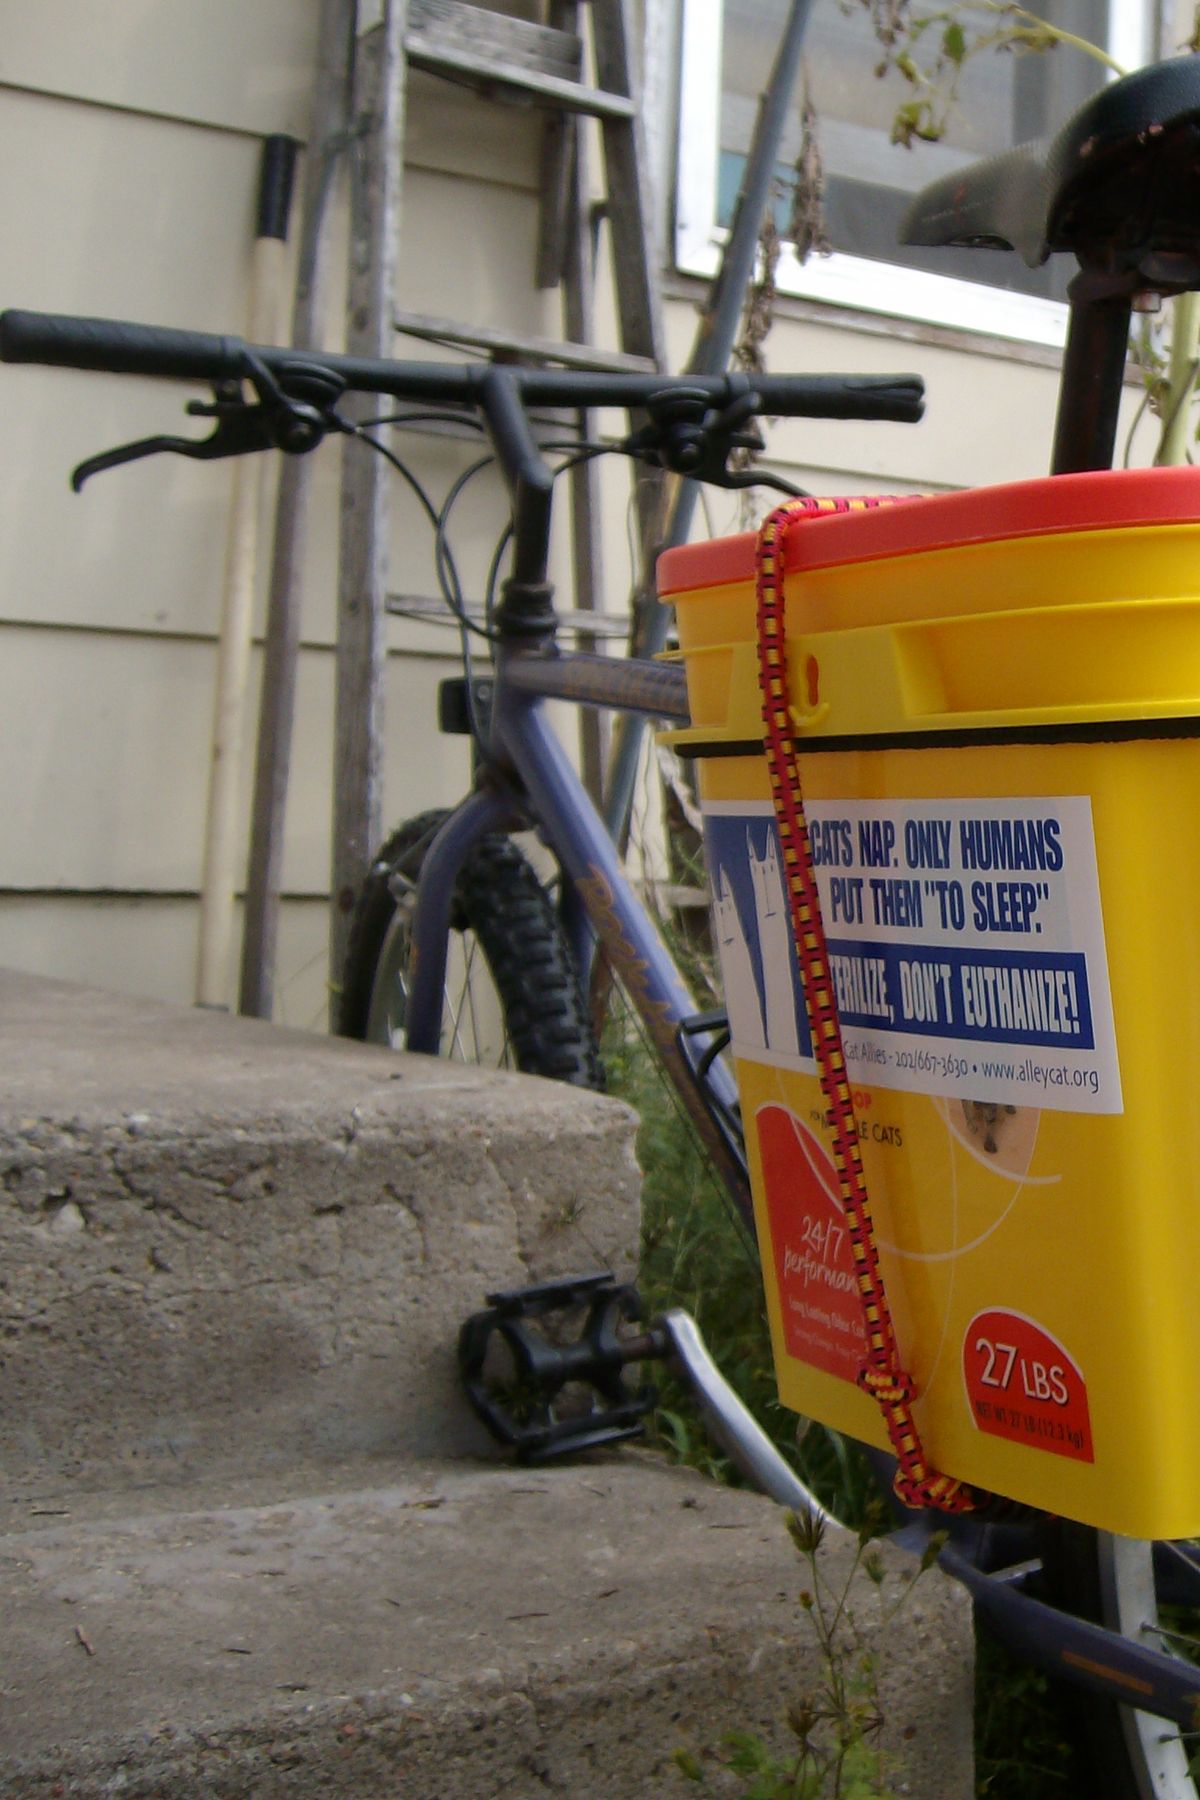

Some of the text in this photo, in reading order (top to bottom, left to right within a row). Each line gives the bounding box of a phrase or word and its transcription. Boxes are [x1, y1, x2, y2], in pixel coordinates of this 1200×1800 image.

[808, 818, 1064, 872] CATS NAP. ONLY HUMANS
[829, 876, 864, 924] PUT
[869, 877, 924, 929] THEM
[924, 879, 965, 932] "TO
[899, 959, 953, 1025] DON'T
[960, 965, 1081, 1035] EUTHANIZE!
[861, 1040, 887, 1066] Allies
[895, 1049, 969, 1079] 202/667-3630
[980, 1058, 1100, 1095] www.alleycat.org
[871, 1120, 903, 1148] CATS
[801, 1215, 845, 1264] 24/7
[975, 1338, 1069, 1406] 27 LBS
